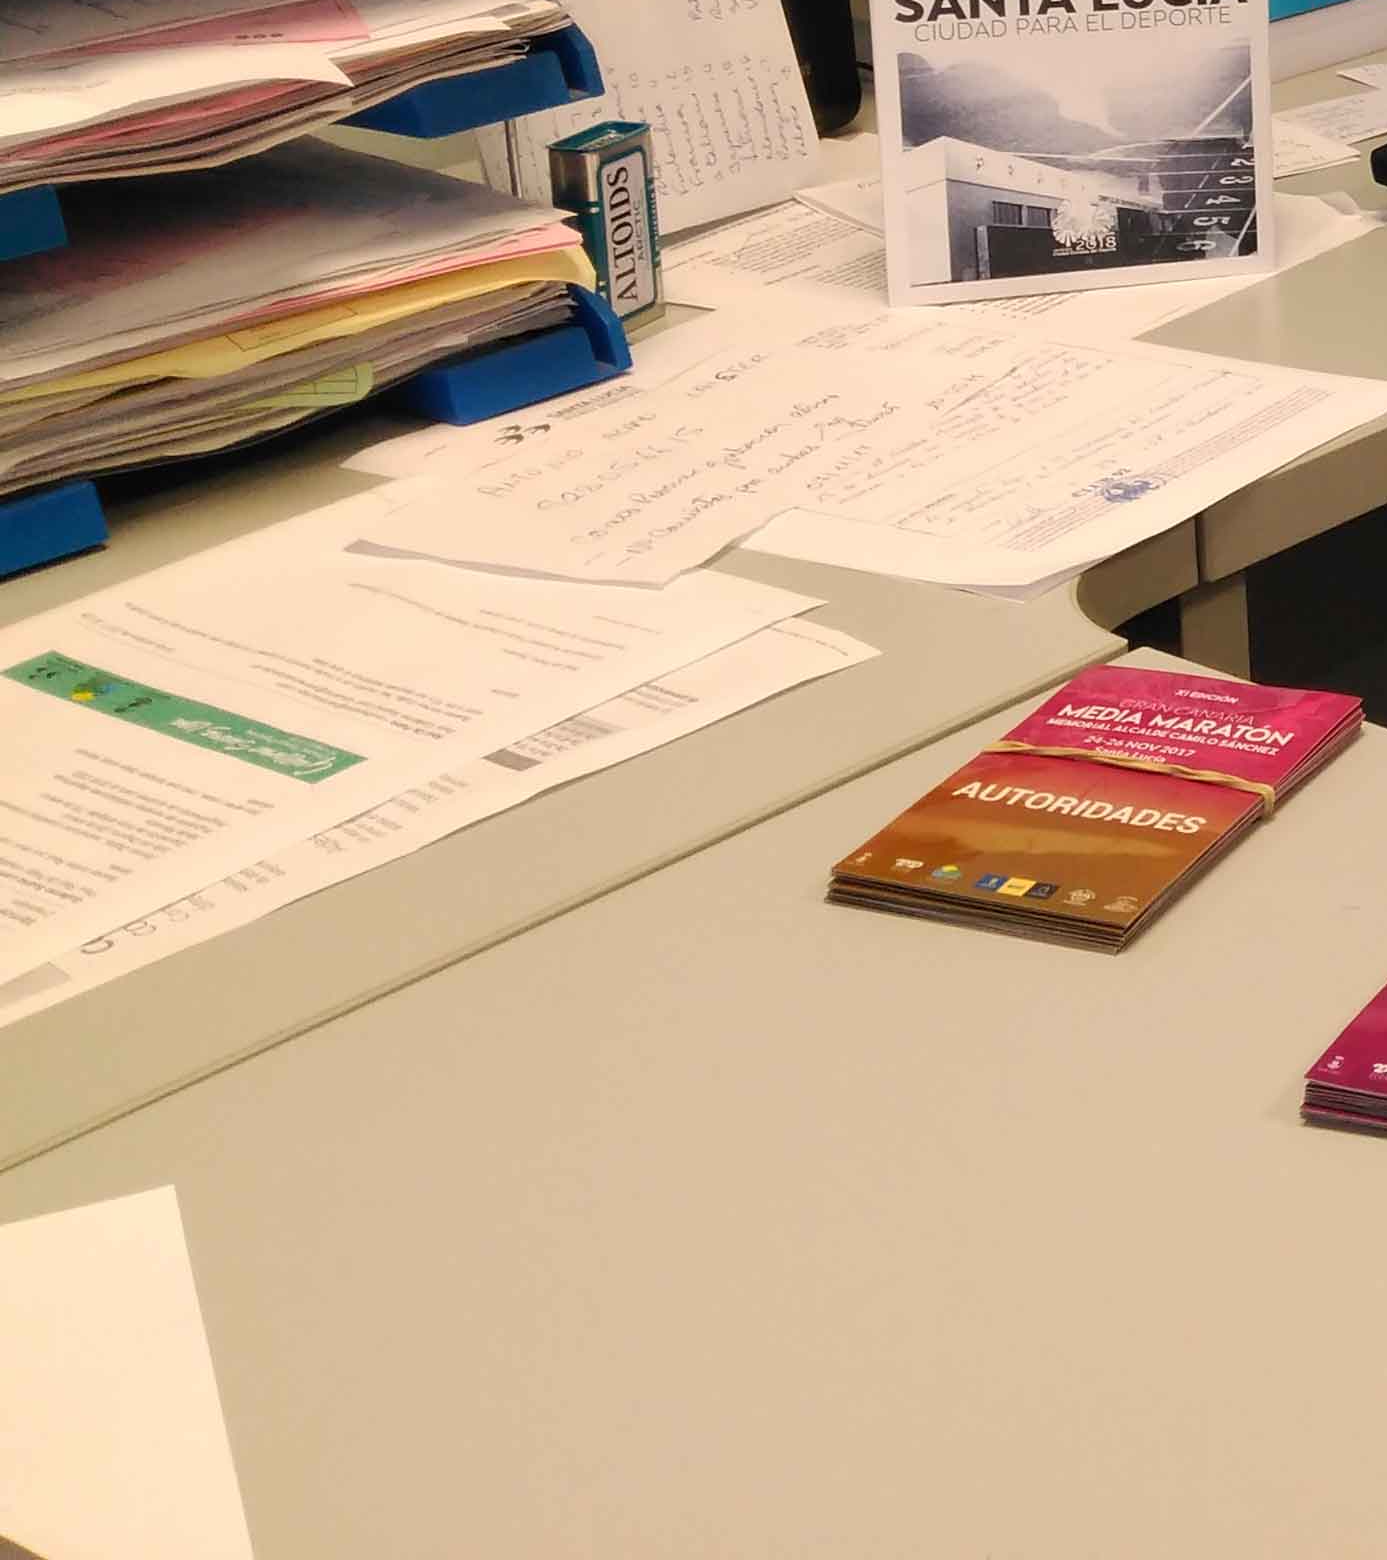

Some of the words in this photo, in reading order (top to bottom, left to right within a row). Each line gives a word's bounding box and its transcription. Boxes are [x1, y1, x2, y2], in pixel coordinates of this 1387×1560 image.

[914, 19, 1008, 43] CIUDAD
[1015, 14, 1080, 37] PARA
[1086, 10, 1113, 32] EL
[1120, 5, 1232, 30] DEPORTE
[606, 165, 640, 304] ALTOIDS
[1075, 235, 1117, 251] 2018
[1120, 699, 1170, 713] GRAN
[1174, 707, 1254, 725] CANARIA
[1189, 689, 1239, 704] EDICIÓN
[1046, 718, 1111, 731] MEMORIAL
[1114, 725, 1167, 737] ALCALDE
[1169, 732, 1217, 745] CAMILO
[1219, 740, 1279, 756] SÁNCHEZ
[1058, 704, 1142, 724] MEDIA
[1149, 715, 1294, 746] MARATÓN
[1084, 736, 1125, 747] 24-26
[1125, 740, 1161, 751] NOV
[1161, 745, 1195, 756] 2017
[951, 780, 1208, 835] AUTORIDADES
